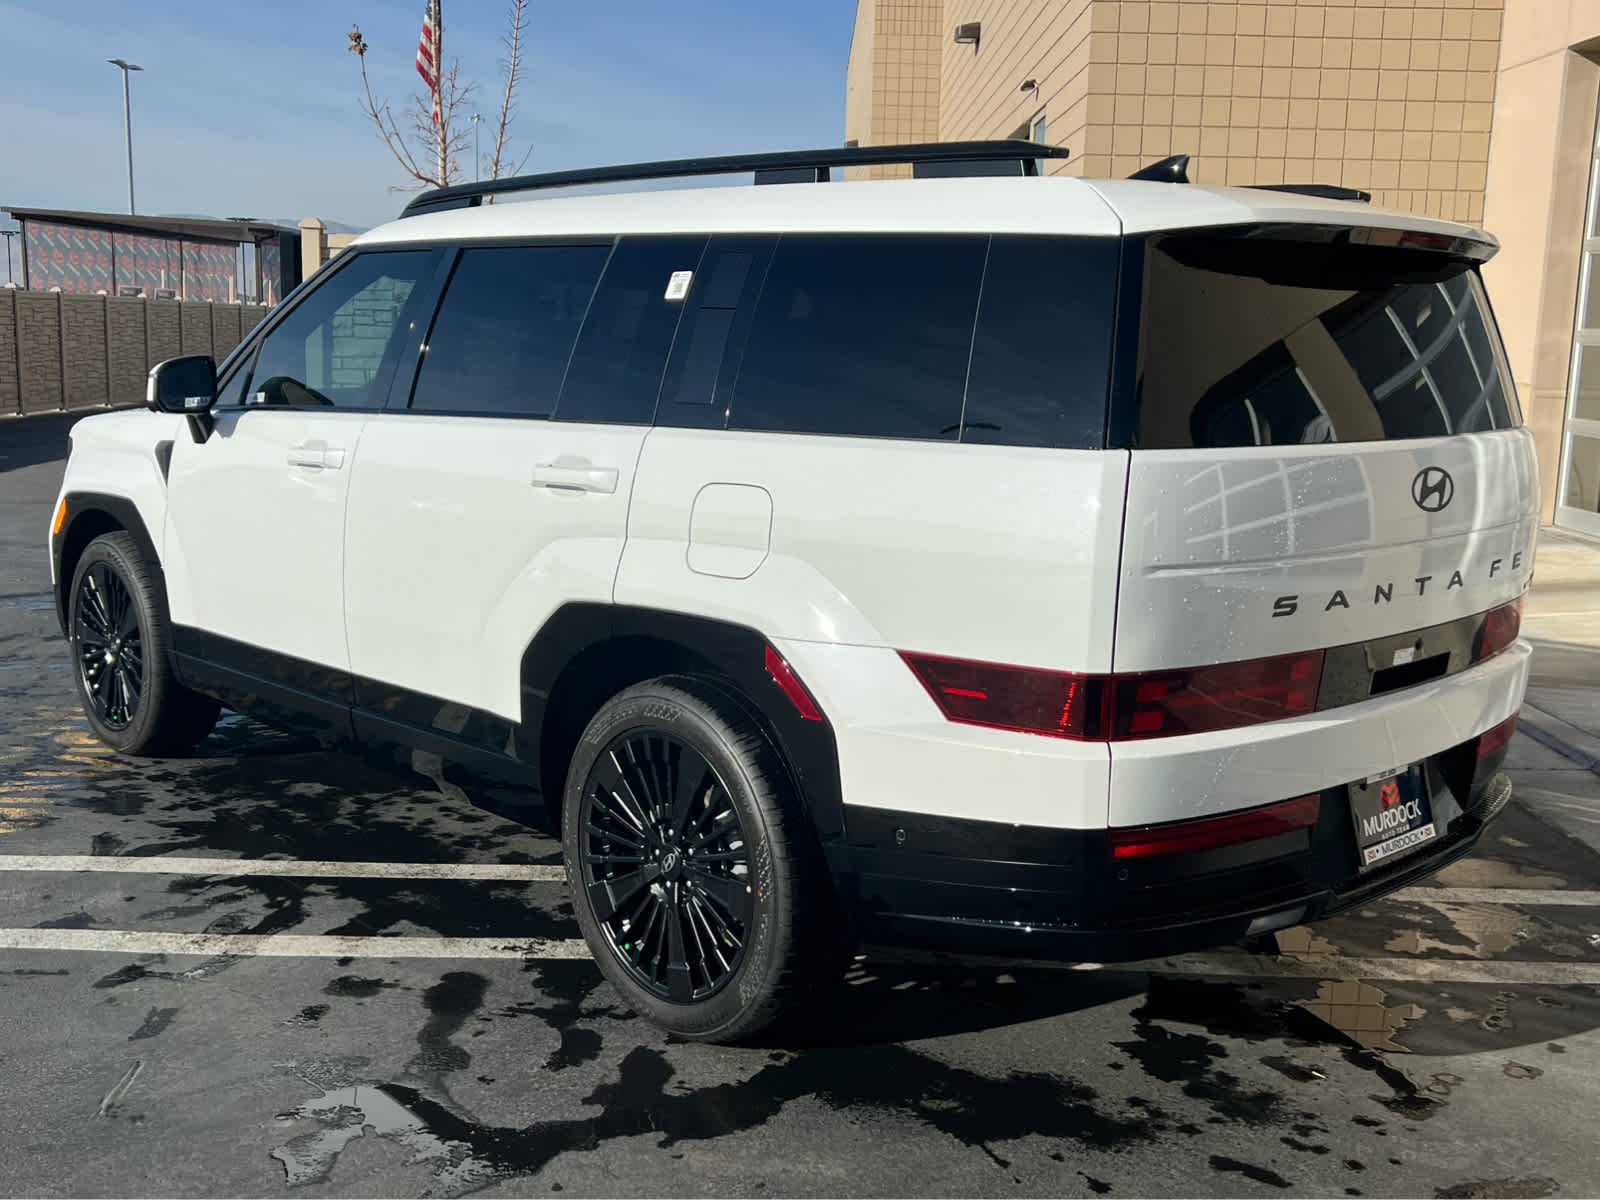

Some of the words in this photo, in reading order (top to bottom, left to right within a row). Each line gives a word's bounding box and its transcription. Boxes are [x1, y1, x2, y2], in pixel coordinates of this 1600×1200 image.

[1272, 570, 1464, 618] SANTA
[1489, 552, 1522, 578] FE
[1363, 798, 1422, 837] MURDOCK
[1381, 832, 1421, 855] MURDOCK
